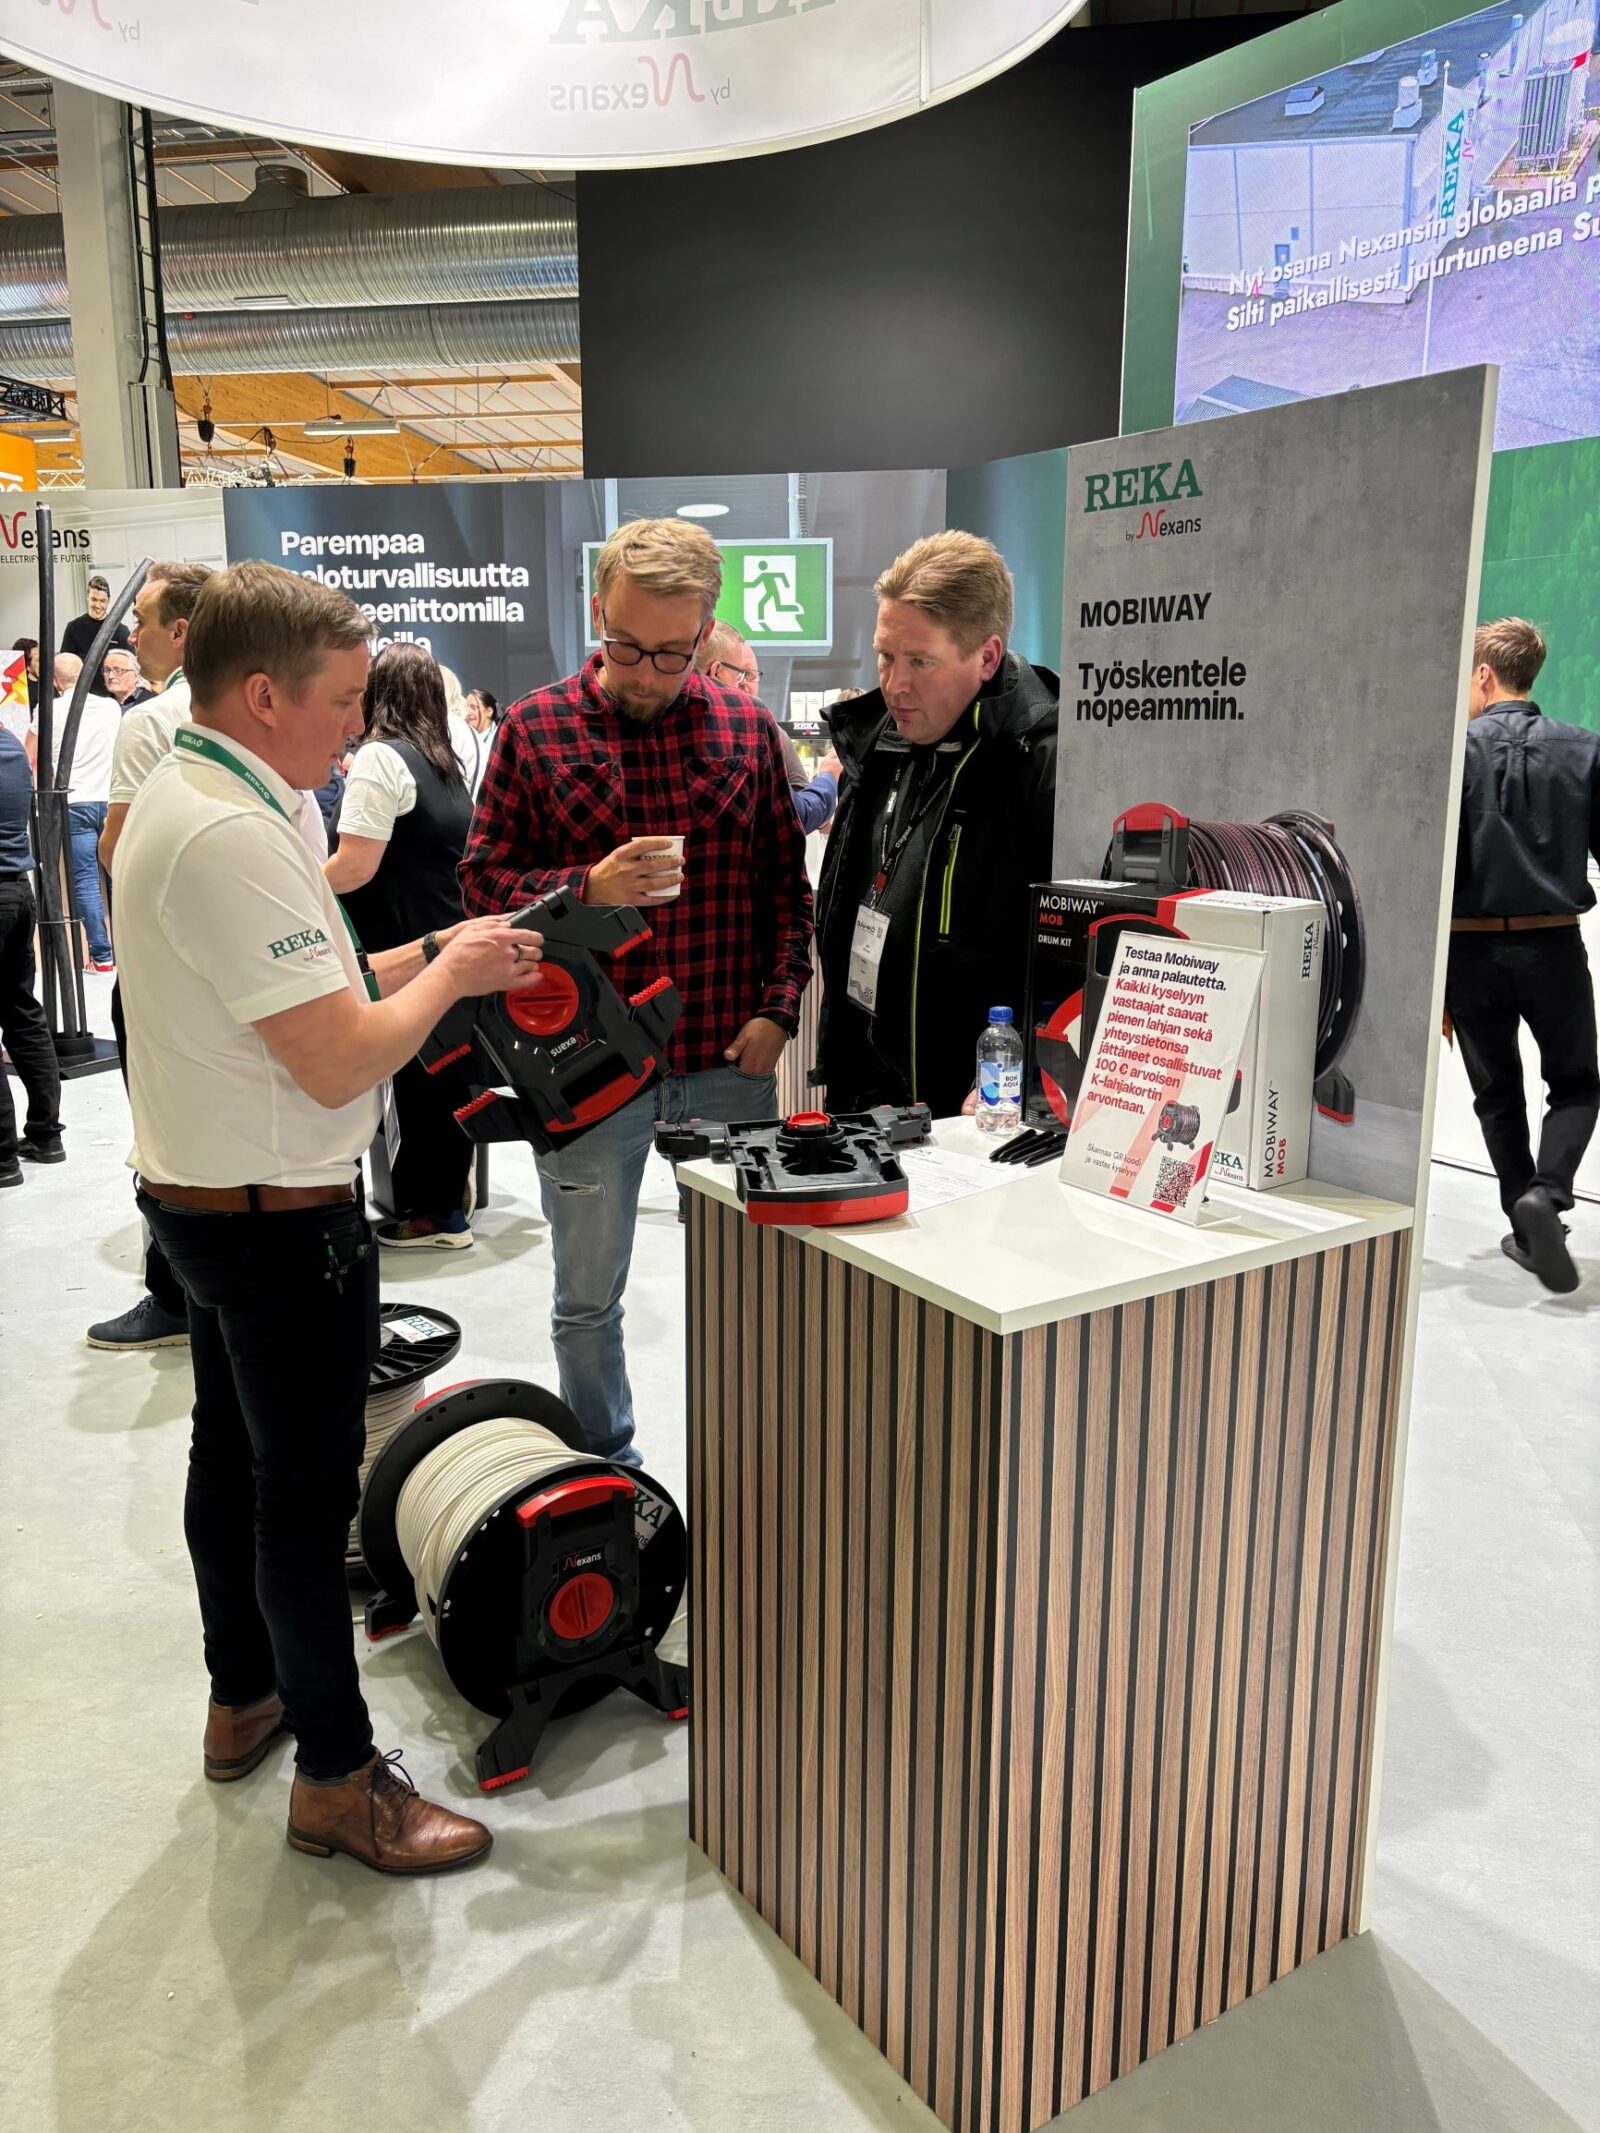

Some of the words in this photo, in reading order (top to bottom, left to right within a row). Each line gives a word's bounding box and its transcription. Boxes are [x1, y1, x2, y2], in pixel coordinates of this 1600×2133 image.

[1441, 108, 1465, 219] REKA
[1228, 267, 1265, 298] Nyt
[1270, 251, 1333, 284] osana
[1338, 214, 1448, 265] Nexansin
[1454, 177, 1578, 240] globaalia
[1225, 299, 1266, 332] Silti
[1269, 262, 1402, 327] paikallisesti
[1402, 226, 1564, 293] juurtuneena
[1083, 458, 1204, 514] REKA
[0, 511, 91, 550] Neans
[1125, 530, 1135, 543] by
[1136, 508, 1202, 540] Nexans
[60, 554, 93, 564] FUTURE
[281, 531, 425, 560] Parempaa
[290, 562, 530, 590] loturvallisuutta
[356, 596, 525, 624] eenittomilla
[1080, 592, 1212, 629] MOBIWAY
[1078, 656, 1247, 697] Työskentele
[1076, 690, 1245, 728] nopeammin.
[1038, 912, 1064, 926] MOB
[267, 928, 328, 960] REKA
[1037, 934, 1060, 945] DRUM
[1060, 937, 1073, 948] KIT
[1301, 921, 1315, 980] REKA
[1125, 945, 1162, 962] Testaa
[1164, 951, 1220, 974] Mobiway
[1118, 961, 1130, 976] ja
[1131, 966, 1160, 980] anna
[1160, 969, 1227, 992] palautetta.
[1115, 978, 1151, 994] Kaikki
[1151, 985, 1205, 1007] kyselyyn
[1112, 995, 1166, 1016] vastaajat
[1166, 1006, 1209, 1024] saavat
[1102, 1026, 1190, 1055] yhteystietonsa
[1107, 1011, 1146, 1029] pienen
[1146, 1016, 1182, 1036] lahjan
[1183, 1026, 1214, 1043] sekä
[1095, 1058, 1118, 1072] 100
[1118, 1062, 1129, 1076] €
[1129, 1067, 1181, 1089] arvoisen
[1097, 1041, 1152, 1063] jättäneet
[1152, 1054, 1223, 1081] osallistuvat
[1087, 1090, 1146, 1116] arvontaan.
[1091, 1073, 1163, 1102] K-lahjakortin
[1213, 1151, 1244, 1170] EKA
[1276, 1138, 1287, 1175] MOB
[634, 1488, 663, 1529] KA
[562, 1552, 602, 1571] Nexans
